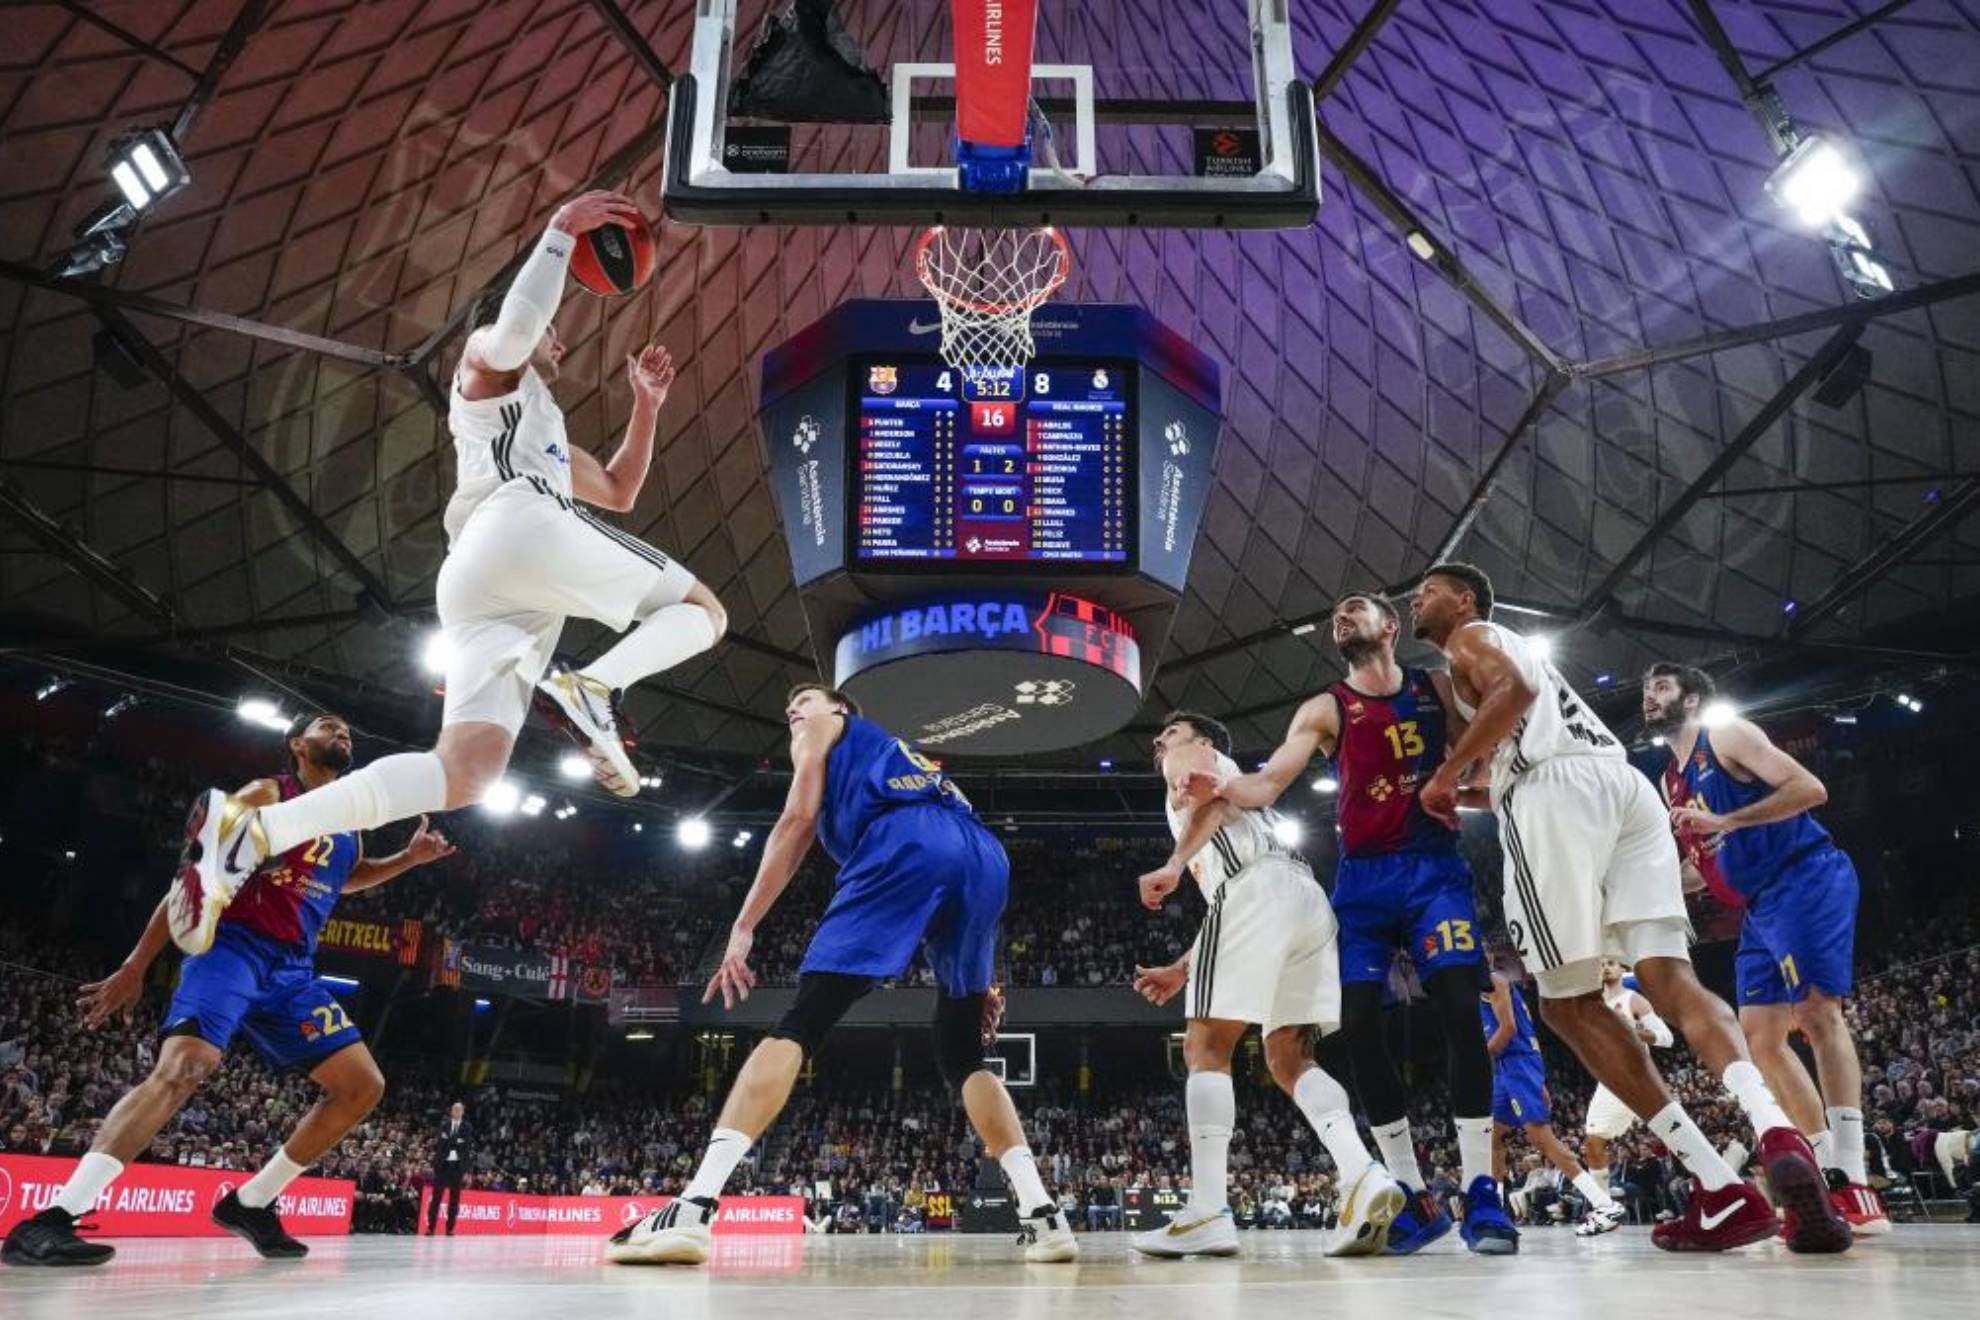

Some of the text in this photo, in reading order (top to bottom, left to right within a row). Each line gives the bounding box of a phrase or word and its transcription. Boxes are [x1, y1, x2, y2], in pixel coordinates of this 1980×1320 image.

[985, 0, 1002, 65] IRLINES
[936, 371, 952, 392] 4
[976, 380, 1010, 396] 5:12
[1034, 373, 1049, 394] 8
[982, 408, 1005, 427] 16
[973, 460, 981, 473] 1
[1004, 460, 1013, 473] 2
[972, 499, 982, 513] 0
[1003, 499, 1014, 513] 0
[901, 602, 1029, 640] BARÇA
[1384, 721, 1425, 759] 13
[303, 831, 334, 867] 22
[1437, 919, 1475, 952] 13
[462, 956, 551, 981] Sang Culé
[312, 1002, 354, 1036] 22
[20, 1183, 195, 1213] TURH AIRLINES
[297, 1197, 347, 1216] AIRLINES
[723, 1208, 795, 1222] AIRLINES
